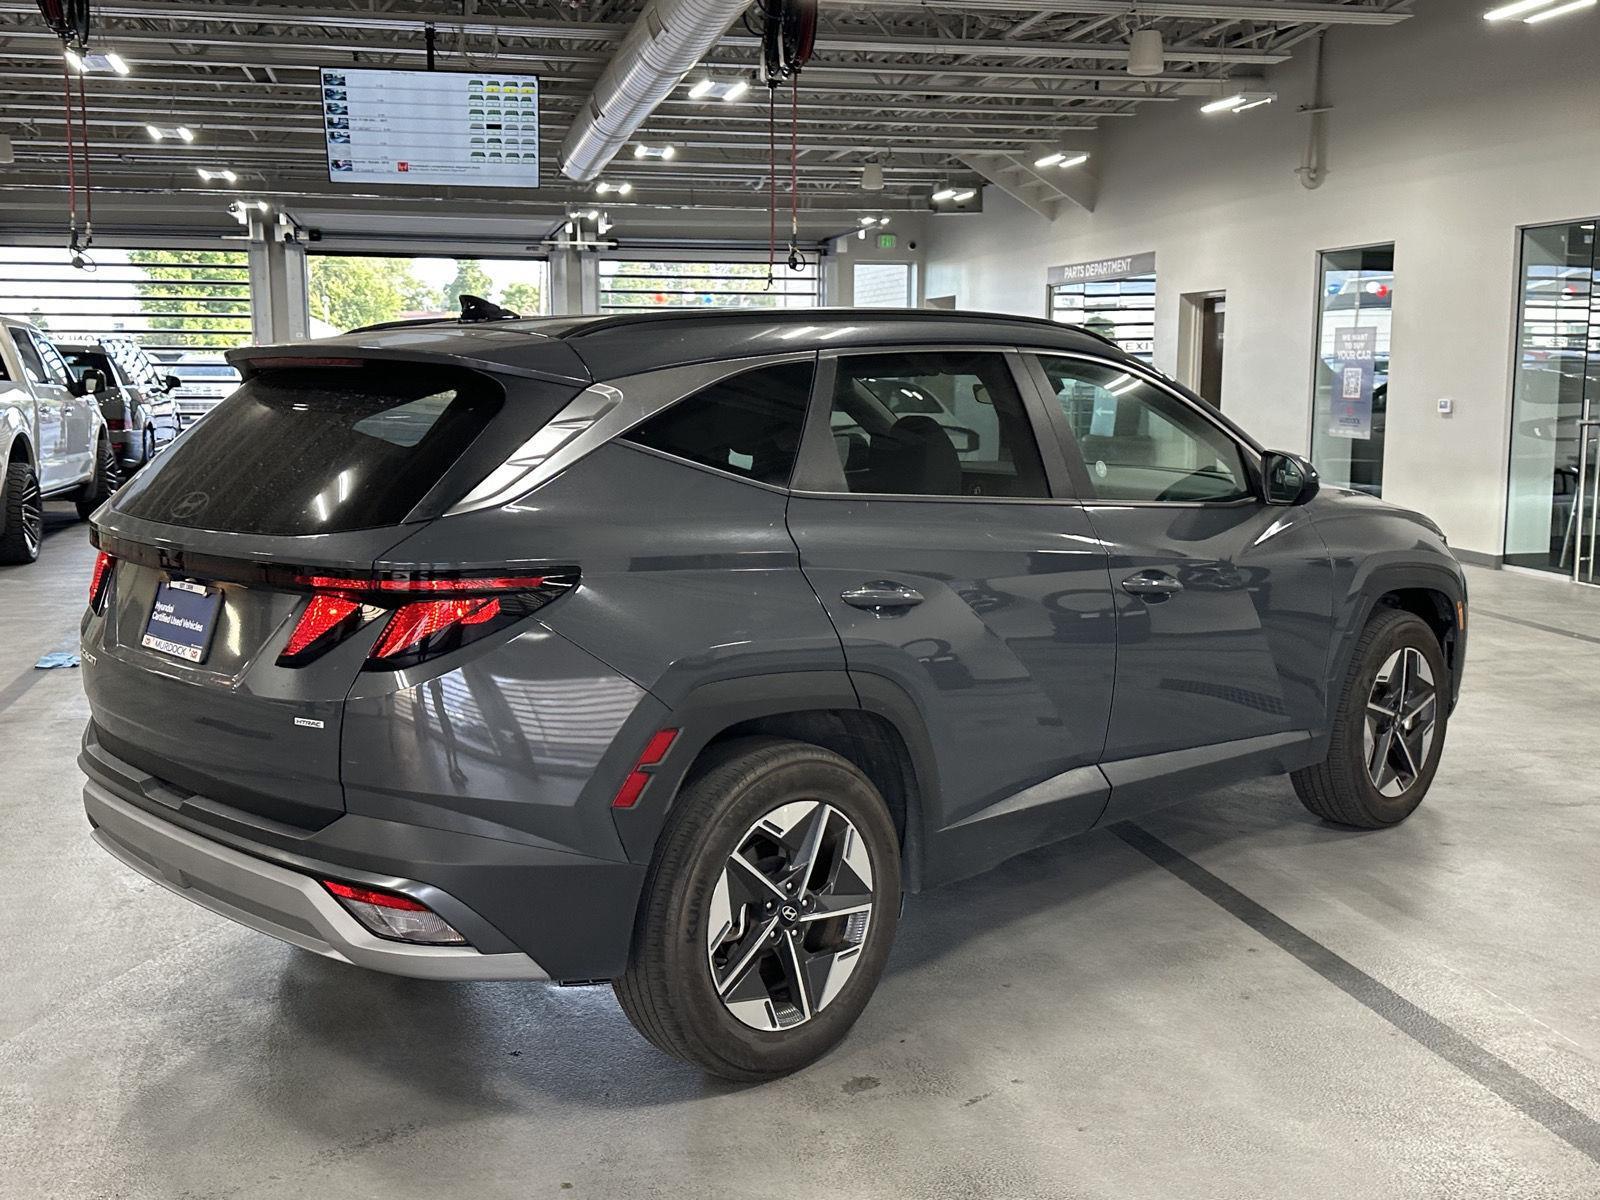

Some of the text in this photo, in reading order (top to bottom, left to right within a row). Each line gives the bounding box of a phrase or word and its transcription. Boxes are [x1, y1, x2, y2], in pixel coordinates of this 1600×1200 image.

[1064, 258, 1132, 279] PARTS DEPARTMENT
[1125, 342, 1154, 351] EXI
[1337, 350, 1372, 360] YOUR CAR
[154, 600, 175, 614] Hyundai
[151, 611, 204, 633] Certified Used Vehicles
[155, 638, 187, 656] MURDOCK
[295, 719, 321, 727] HTRAC
